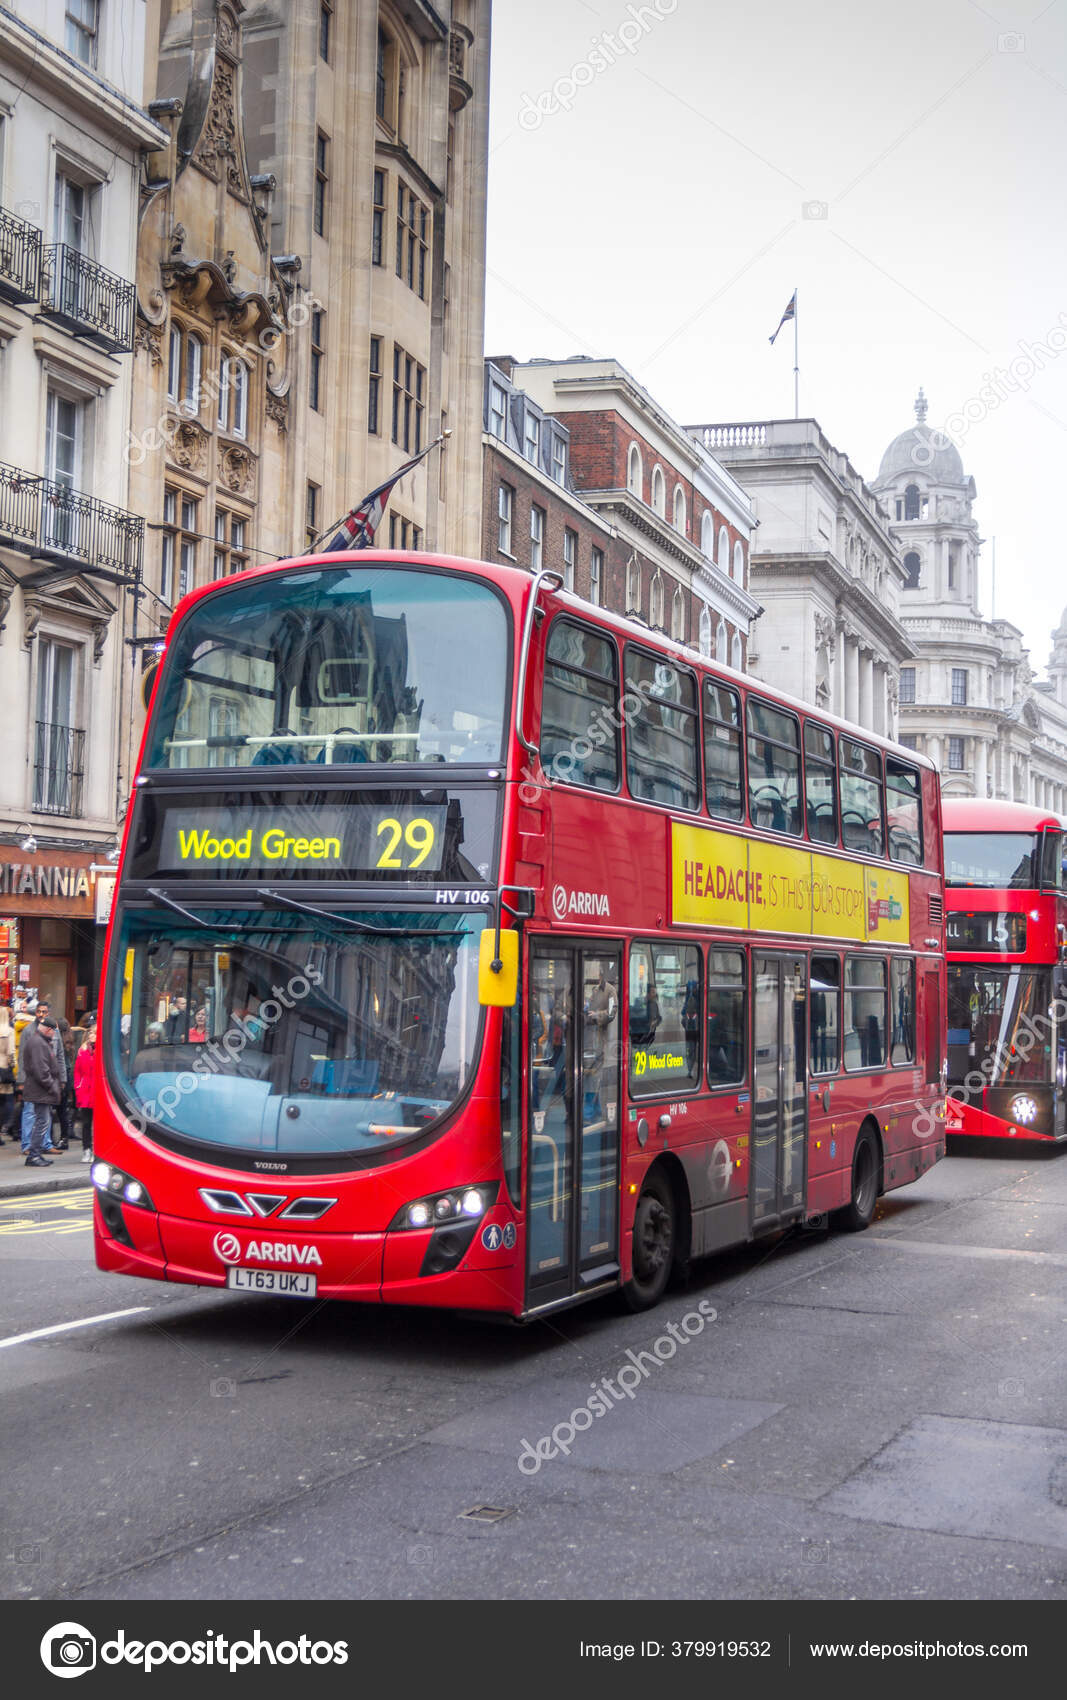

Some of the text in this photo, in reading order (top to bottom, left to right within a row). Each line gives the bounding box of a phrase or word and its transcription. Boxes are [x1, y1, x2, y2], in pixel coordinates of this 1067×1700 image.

[179, 829, 341, 858] Wood Green
[376, 818, 435, 868] 29
[0, 863, 90, 897] ITANNIA
[683, 859, 767, 910] HEADACHE,
[768, 874, 778, 907] IS
[780, 876, 804, 911] THIS
[806, 881, 834, 914] YOUR
[435, 890, 490, 904] HV 106
[568, 890, 610, 917] ARRIVA
[987, 919, 1009, 942] 15
[634, 1051, 684, 1075] 29 Wood Green
[254, 1161, 288, 1170] VOLVO
[245, 1240, 322, 1265] ARRIVA
[235, 1269, 310, 1293] LT63 UKJ
